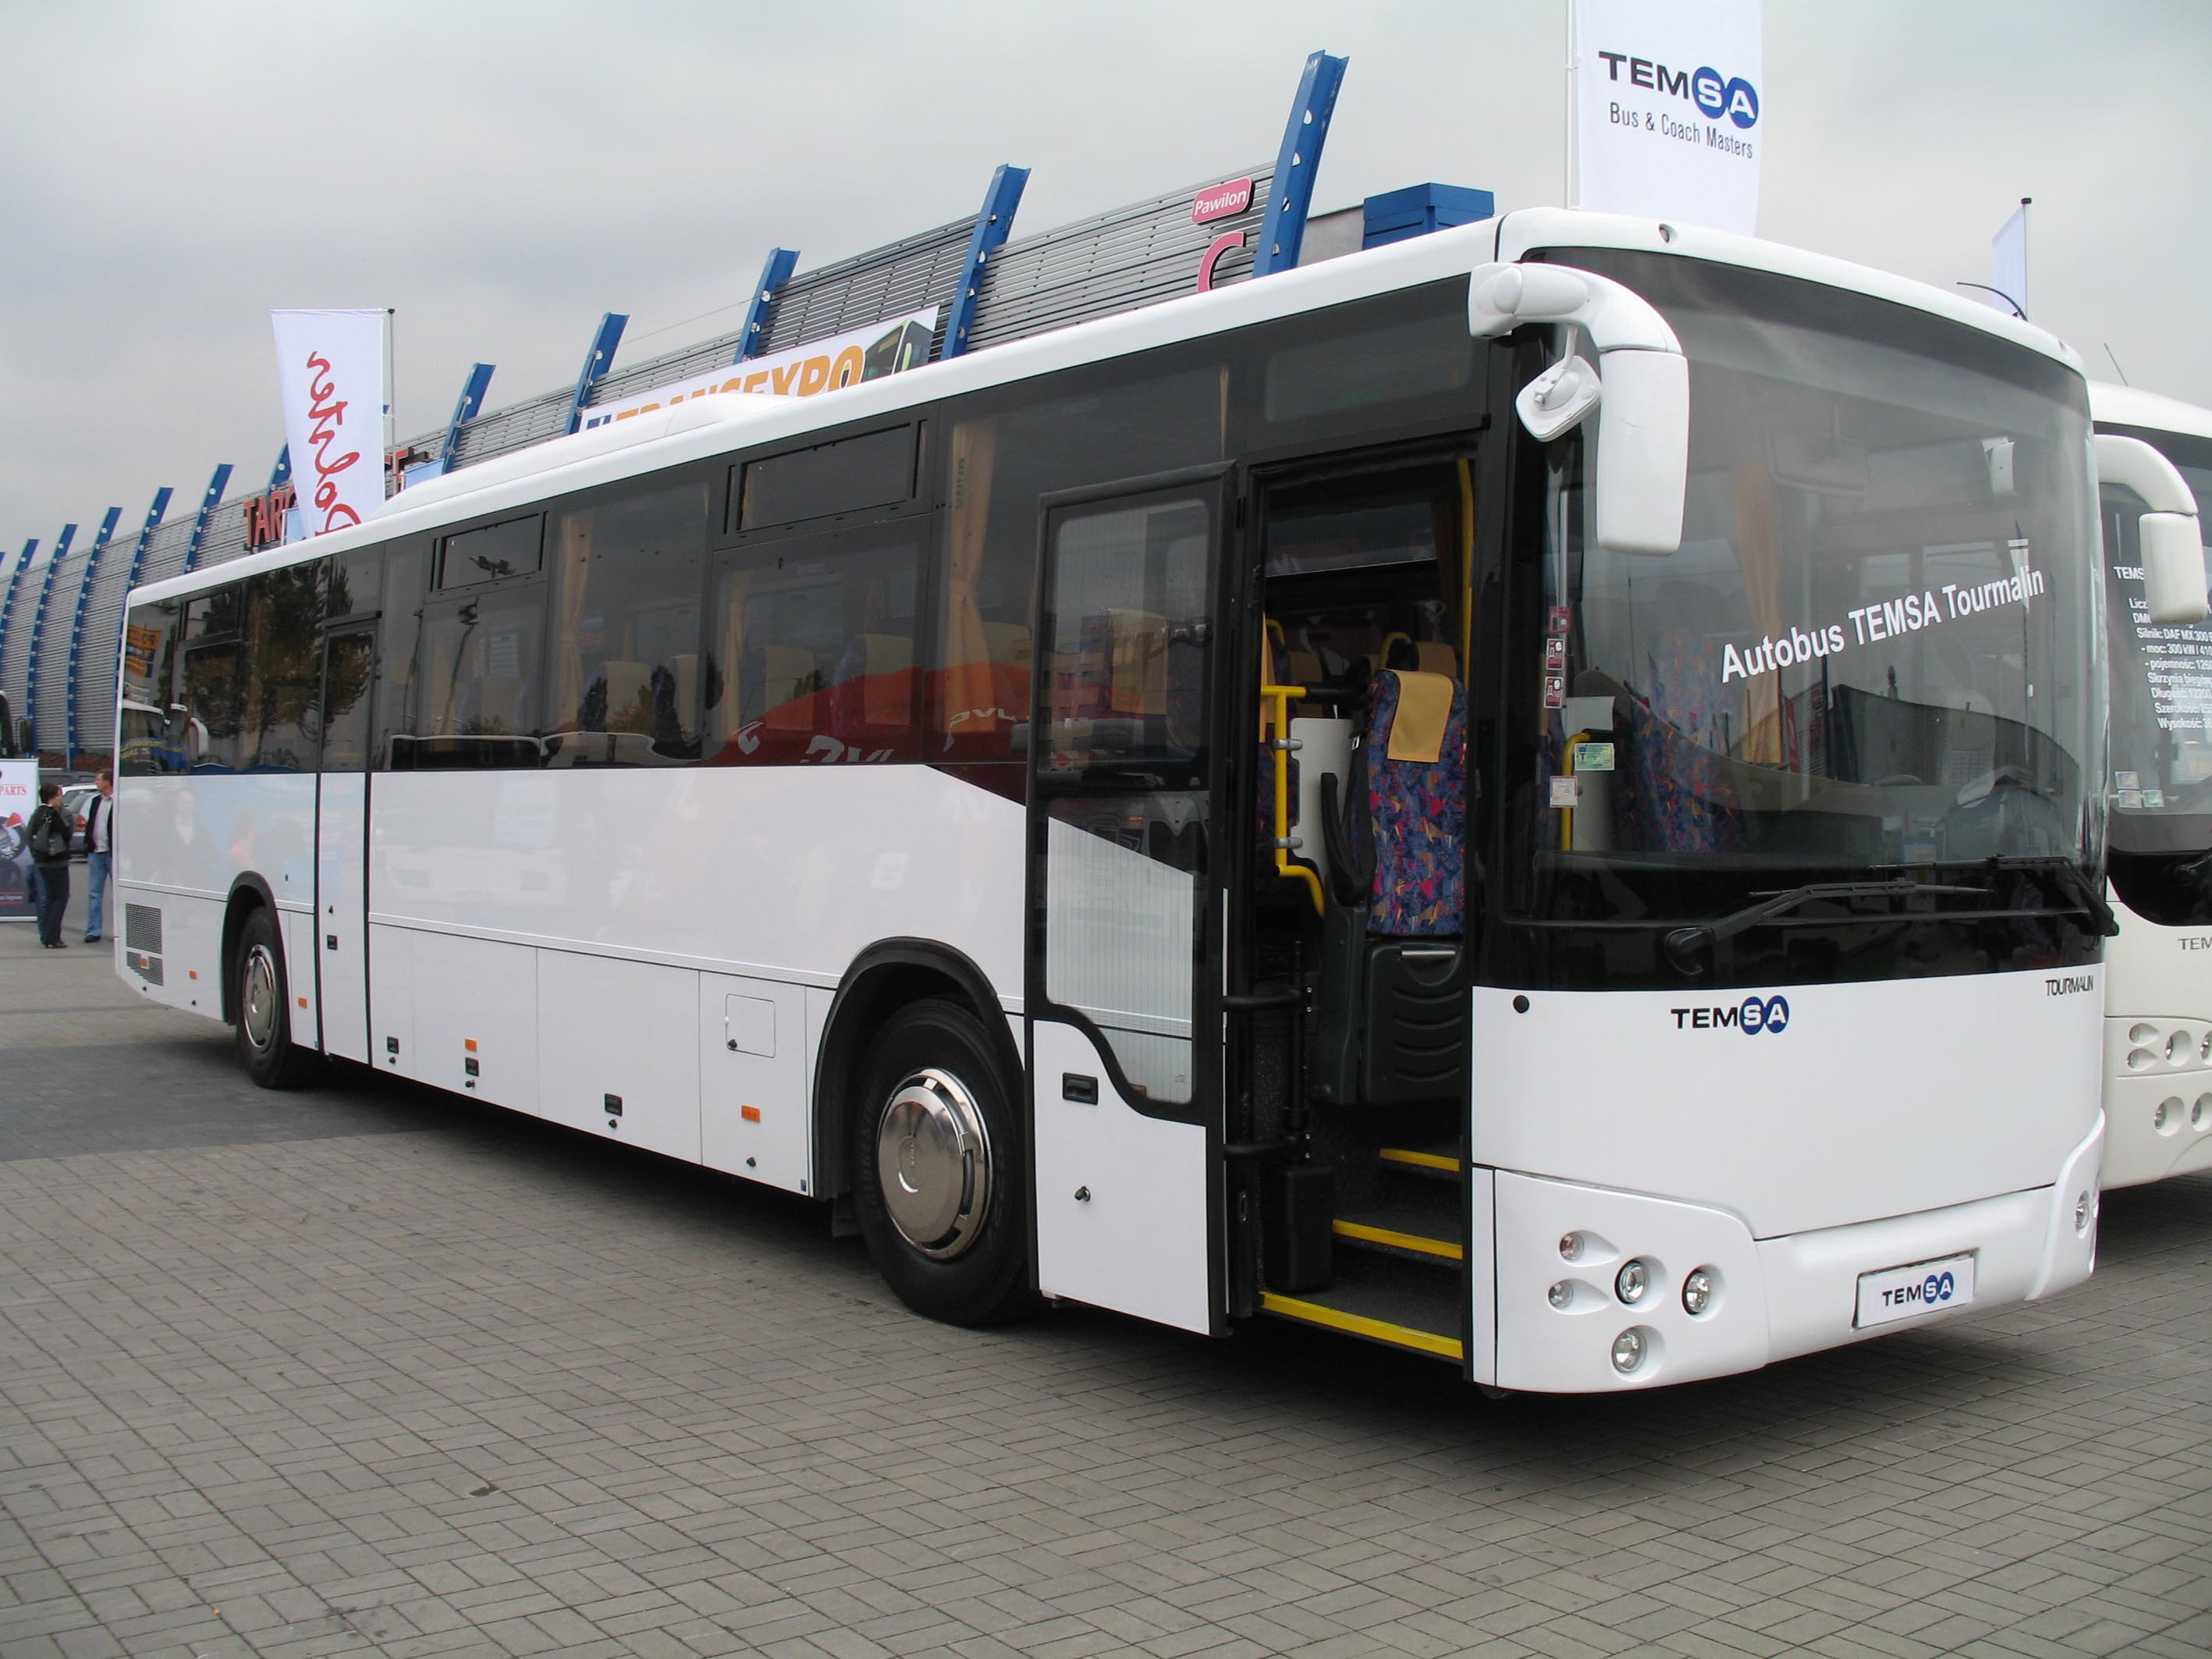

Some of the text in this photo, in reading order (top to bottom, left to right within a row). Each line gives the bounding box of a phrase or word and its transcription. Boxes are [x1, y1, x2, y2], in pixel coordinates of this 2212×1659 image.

[1598, 50, 1757, 123] TEMSA
[1610, 101, 1754, 159] Bus & Coach Masters
[1194, 190, 1247, 216] Pawilon
[2113, 566, 2146, 580] TEMS
[1720, 565, 2045, 684] Autobus TEMSA Tourmalin
[2163, 628, 2181, 640] DAF
[2167, 643, 2182, 654] 300
[2178, 937, 2212, 950] TEM
[2045, 975, 2094, 996] TOURMALIN
[1670, 997, 1788, 1033] TEMSA
[1881, 1274, 1953, 1307] TEMSA
